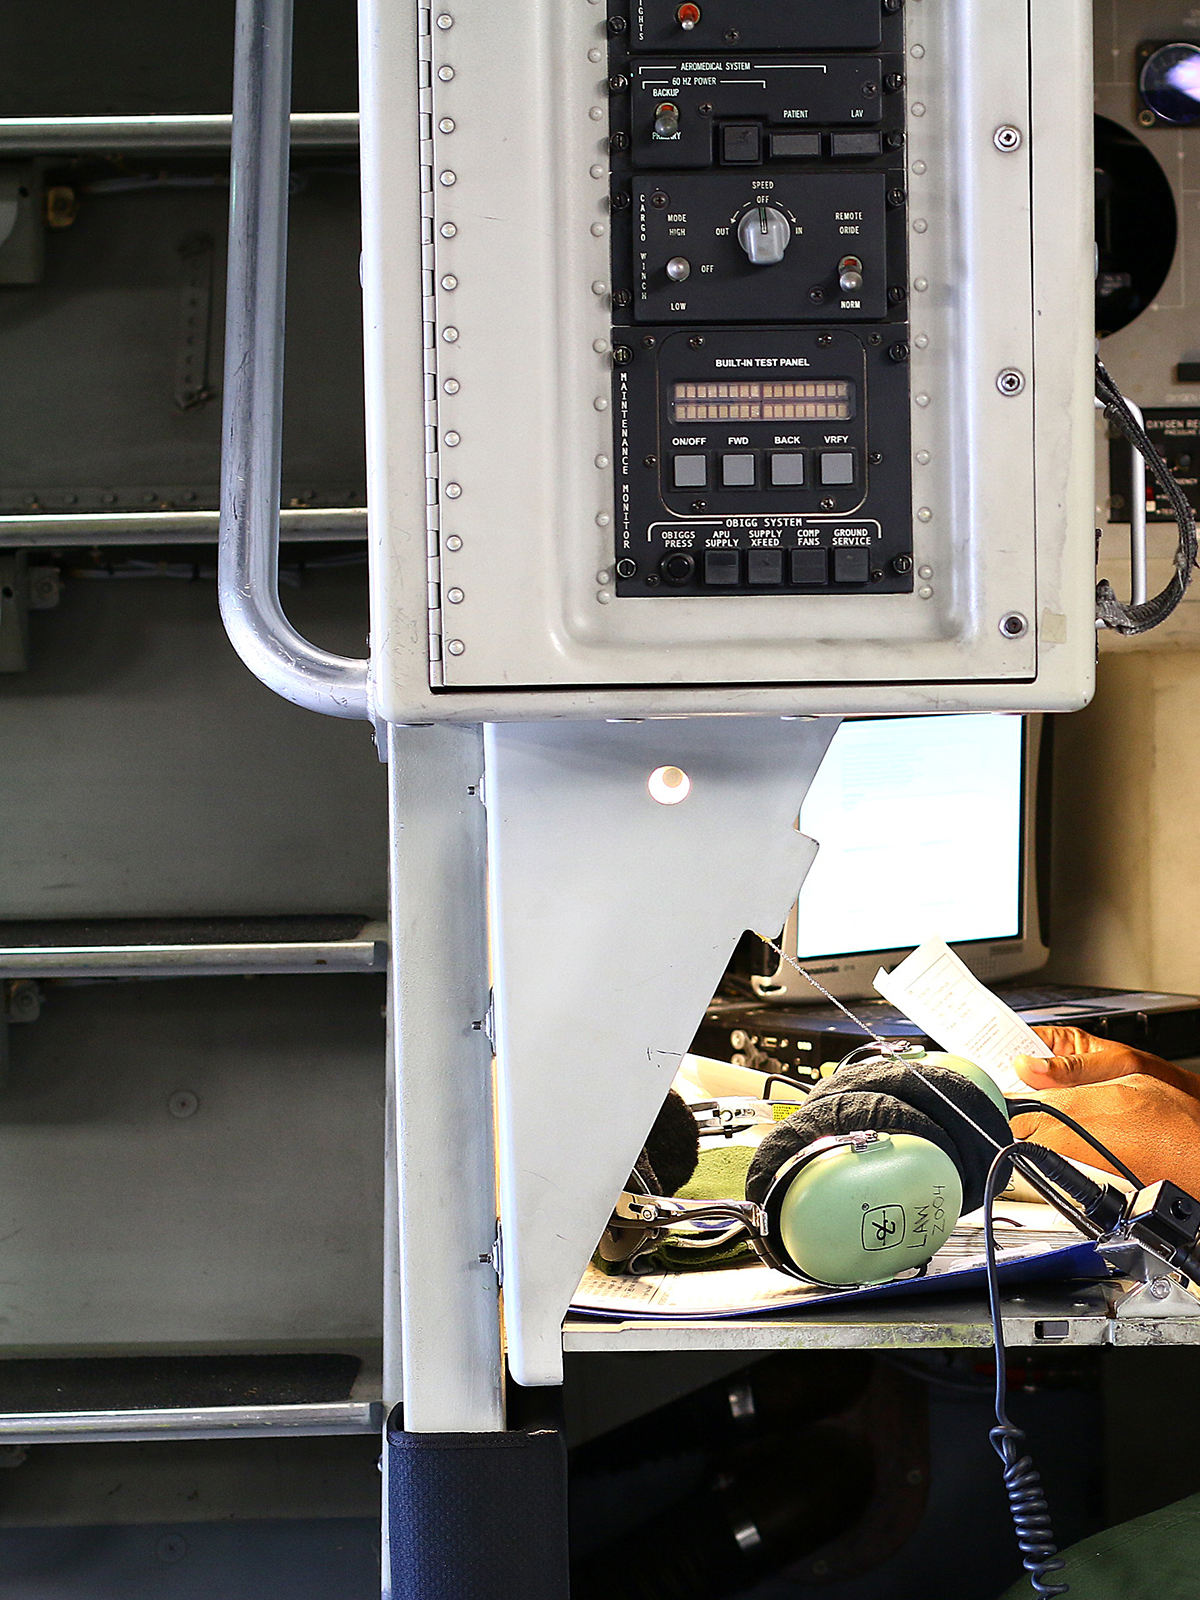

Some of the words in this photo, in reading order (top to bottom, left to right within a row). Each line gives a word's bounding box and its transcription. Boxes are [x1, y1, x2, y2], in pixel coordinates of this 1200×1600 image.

[680, 61, 723, 71] AEROMEDICAL
[725, 61, 751, 71] SYSTEM
[672, 76, 681, 86] 60
[682, 76, 692, 86] HZ
[693, 76, 717, 86] POWER
[652, 88, 680, 97] BACKUP
[783, 109, 809, 119] PATIENT
[850, 109, 864, 118] LAV
[752, 180, 774, 190] SPEED
[756, 195, 770, 204] OFF
[667, 213, 687, 223] MODE
[835, 211, 863, 221] REMOTE
[669, 227, 686, 236] HIGH
[715, 227, 730, 236] OUT
[795, 226, 803, 235] IN
[839, 225, 860, 235] ORIDE
[700, 264, 714, 273] OFF
[670, 302, 687, 311] LOW
[840, 300, 861, 309] NORM
[715, 358, 753, 367] BUILT-IN
[755, 358, 778, 367] TEST
[780, 357, 810, 366] PANEL
[620, 372, 629, 475] MAINTENANCE
[1146, 419, 1184, 428] OXYGEN
[671, 437, 707, 446] ON/OFF
[727, 436, 749, 445] FWD
[774, 435, 801, 445] BACK
[823, 435, 849, 444] VRFY
[622, 484, 631, 549] MONITOR
[725, 518, 758, 528] OBIGG
[763, 518, 803, 527] SYSTEM
[661, 531, 696, 539] OBIGGS
[712, 530, 730, 538] APU
[748, 529, 783, 539] SUPPLY
[796, 528, 821, 538] COMP
[833, 528, 869, 537] GROUND
[664, 538, 693, 548] PRESS
[705, 539, 740, 548] SUPPLY
[751, 538, 781, 547] XFEED
[797, 538, 821, 546] FANS
[831, 537, 872, 546] SERVICE
